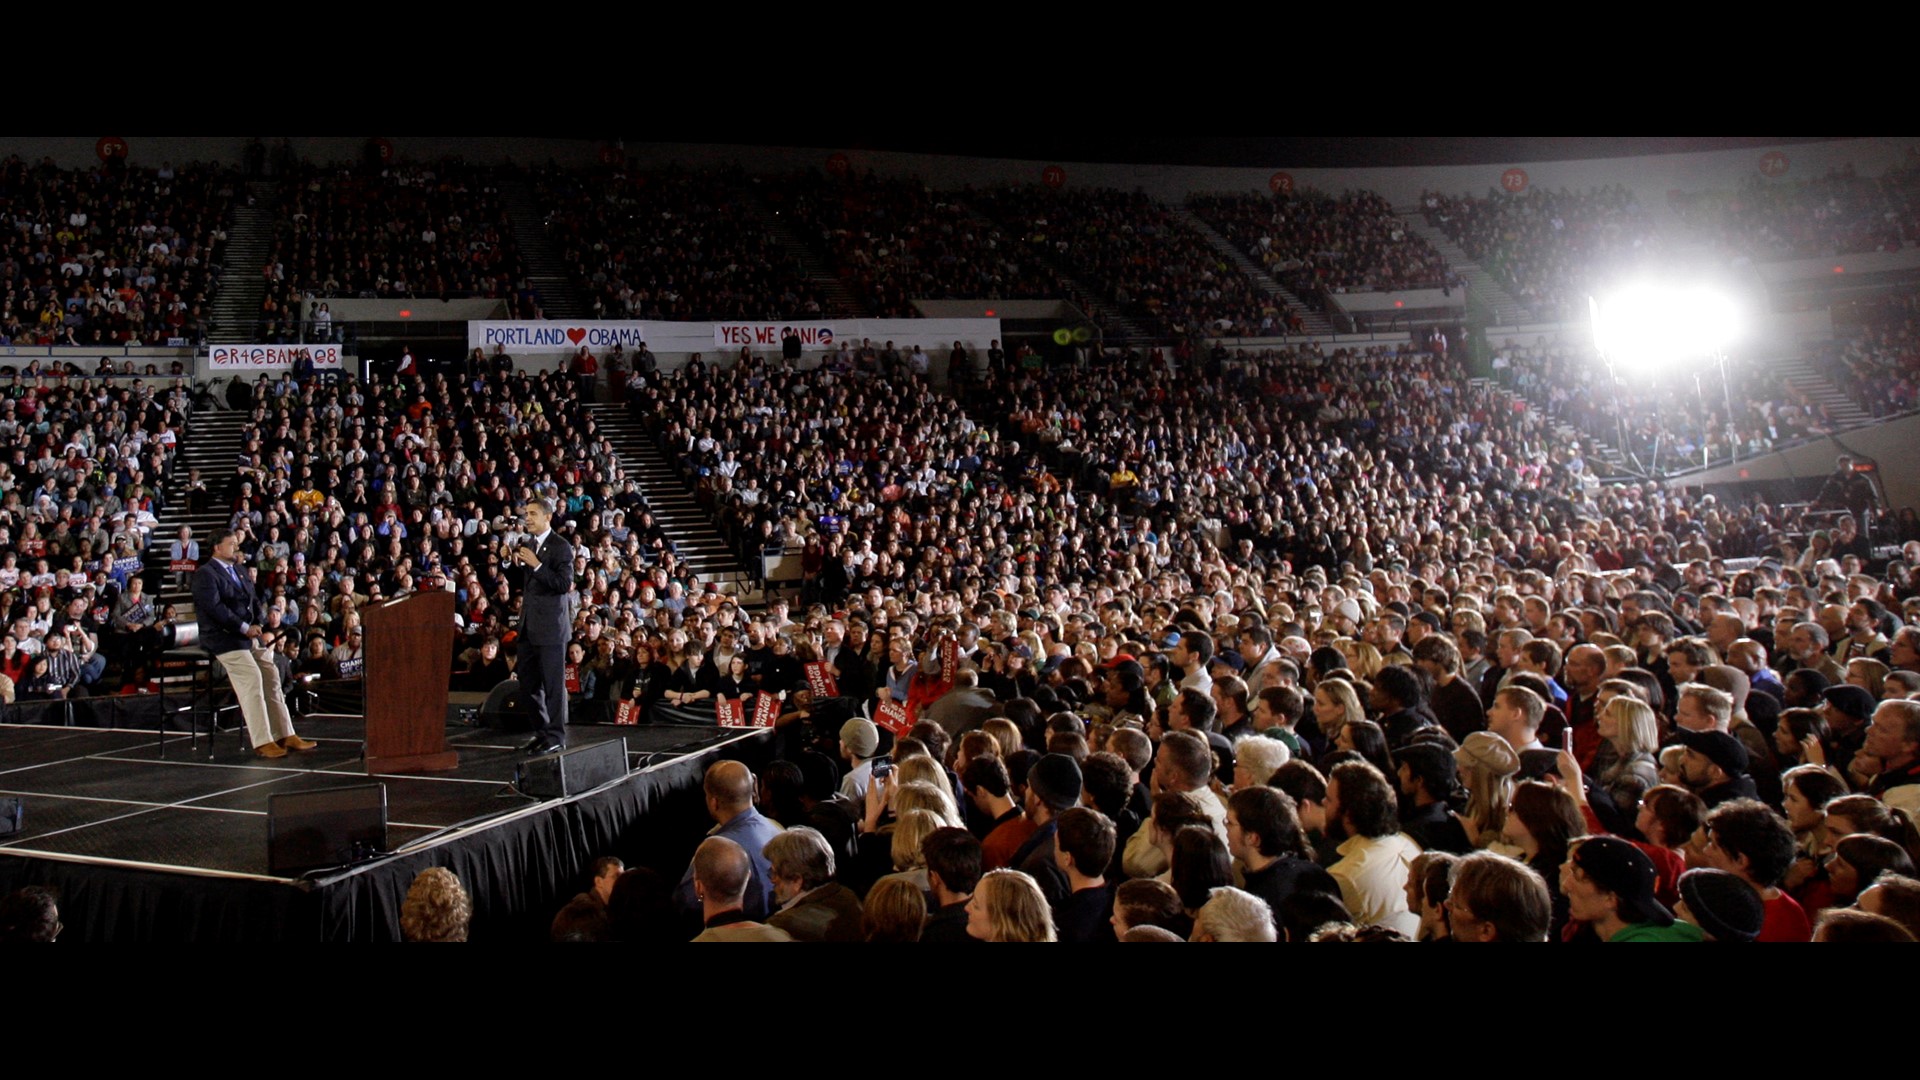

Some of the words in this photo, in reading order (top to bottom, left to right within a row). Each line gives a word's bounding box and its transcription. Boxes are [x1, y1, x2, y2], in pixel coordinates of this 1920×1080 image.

[831, 159, 847, 169] 70
[1048, 172, 1060, 183] 71
[1274, 178, 1289, 190] 72
[1506, 175, 1523, 187] 73
[486, 327, 565, 345] PORTLAND
[589, 328, 642, 346] OBAMA
[722, 326, 752, 345] YES
[755, 326, 776, 344] WE
[811, 680, 821, 697] TAND
[724, 703, 734, 727] ANGE
[754, 707, 763, 727] TAND
[759, 693, 767, 707] FOR
[759, 694, 772, 727] HANGE
[880, 704, 906, 725] CHANGE
